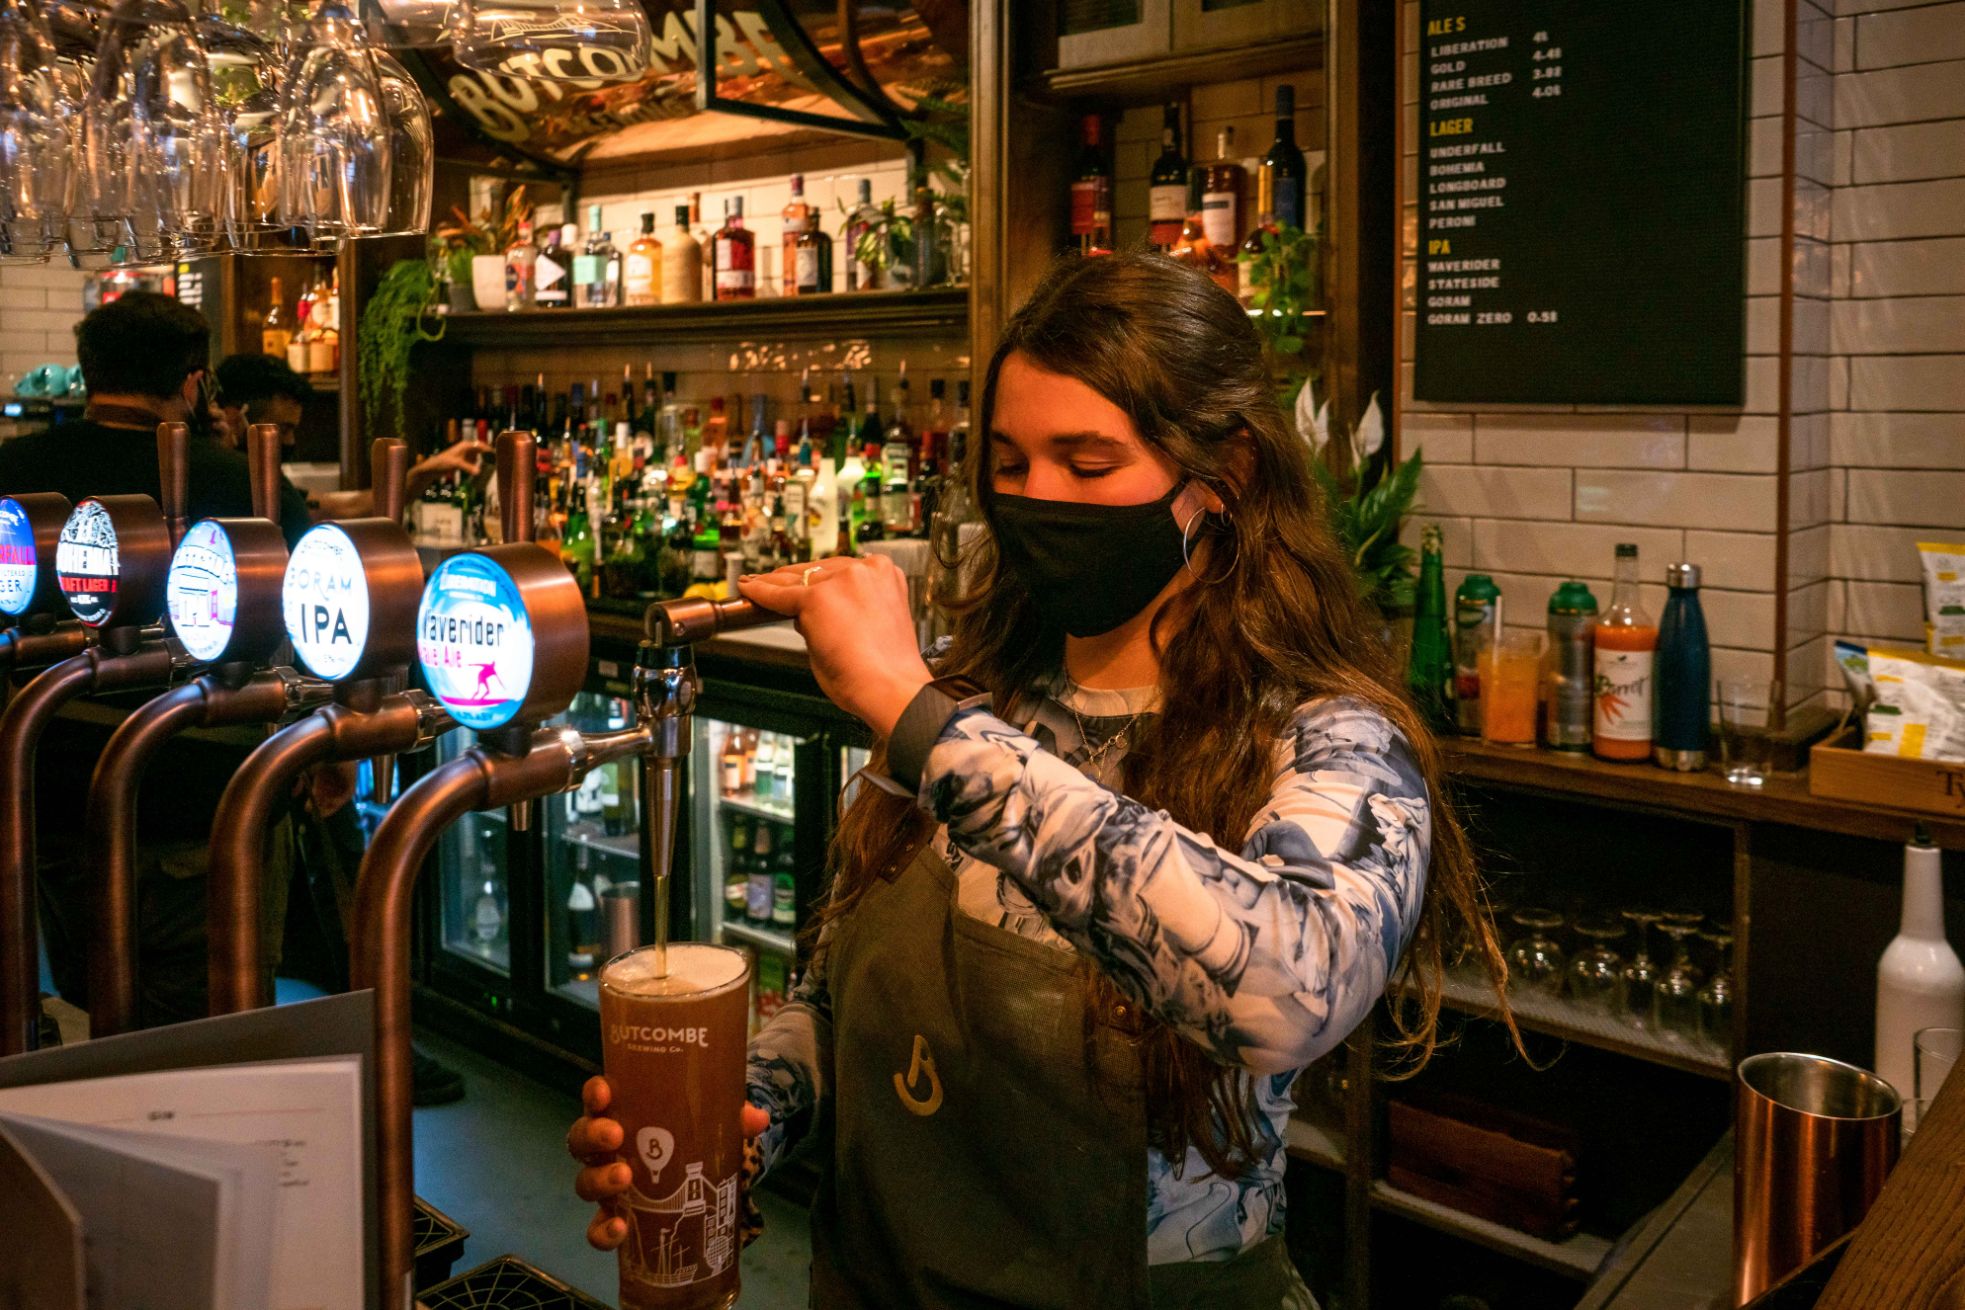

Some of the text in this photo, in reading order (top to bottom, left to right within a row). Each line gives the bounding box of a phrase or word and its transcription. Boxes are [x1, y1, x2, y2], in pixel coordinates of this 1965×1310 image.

[1430, 36, 1510, 58] LIBERATION
[1429, 60, 1467, 75] GOLD
[1430, 78, 1465, 93] RARE
[1467, 72, 1513, 88] BREED
[1429, 94, 1489, 111] ORIGINAL
[1429, 117, 1474, 137] LAGER
[1429, 141, 1507, 159] UNDERFALL
[1429, 161, 1485, 177] BOHEMIA
[1429, 177, 1507, 194] LONGBOARD
[1429, 195, 1505, 212] SAN MIGUEL
[1428, 215, 1477, 230] PERONI
[1427, 239, 1452, 256] IPA
[1427, 258, 1502, 272] WAVERIDER
[1427, 276, 1501, 290] STATESIDE
[1427, 295, 1472, 308] GORAM
[1427, 312, 1472, 325] GORAM
[1476, 311, 1513, 324] ZERO
[301, 603, 353, 645] IPA
[610, 1024, 709, 1048] BUTCOMBE
